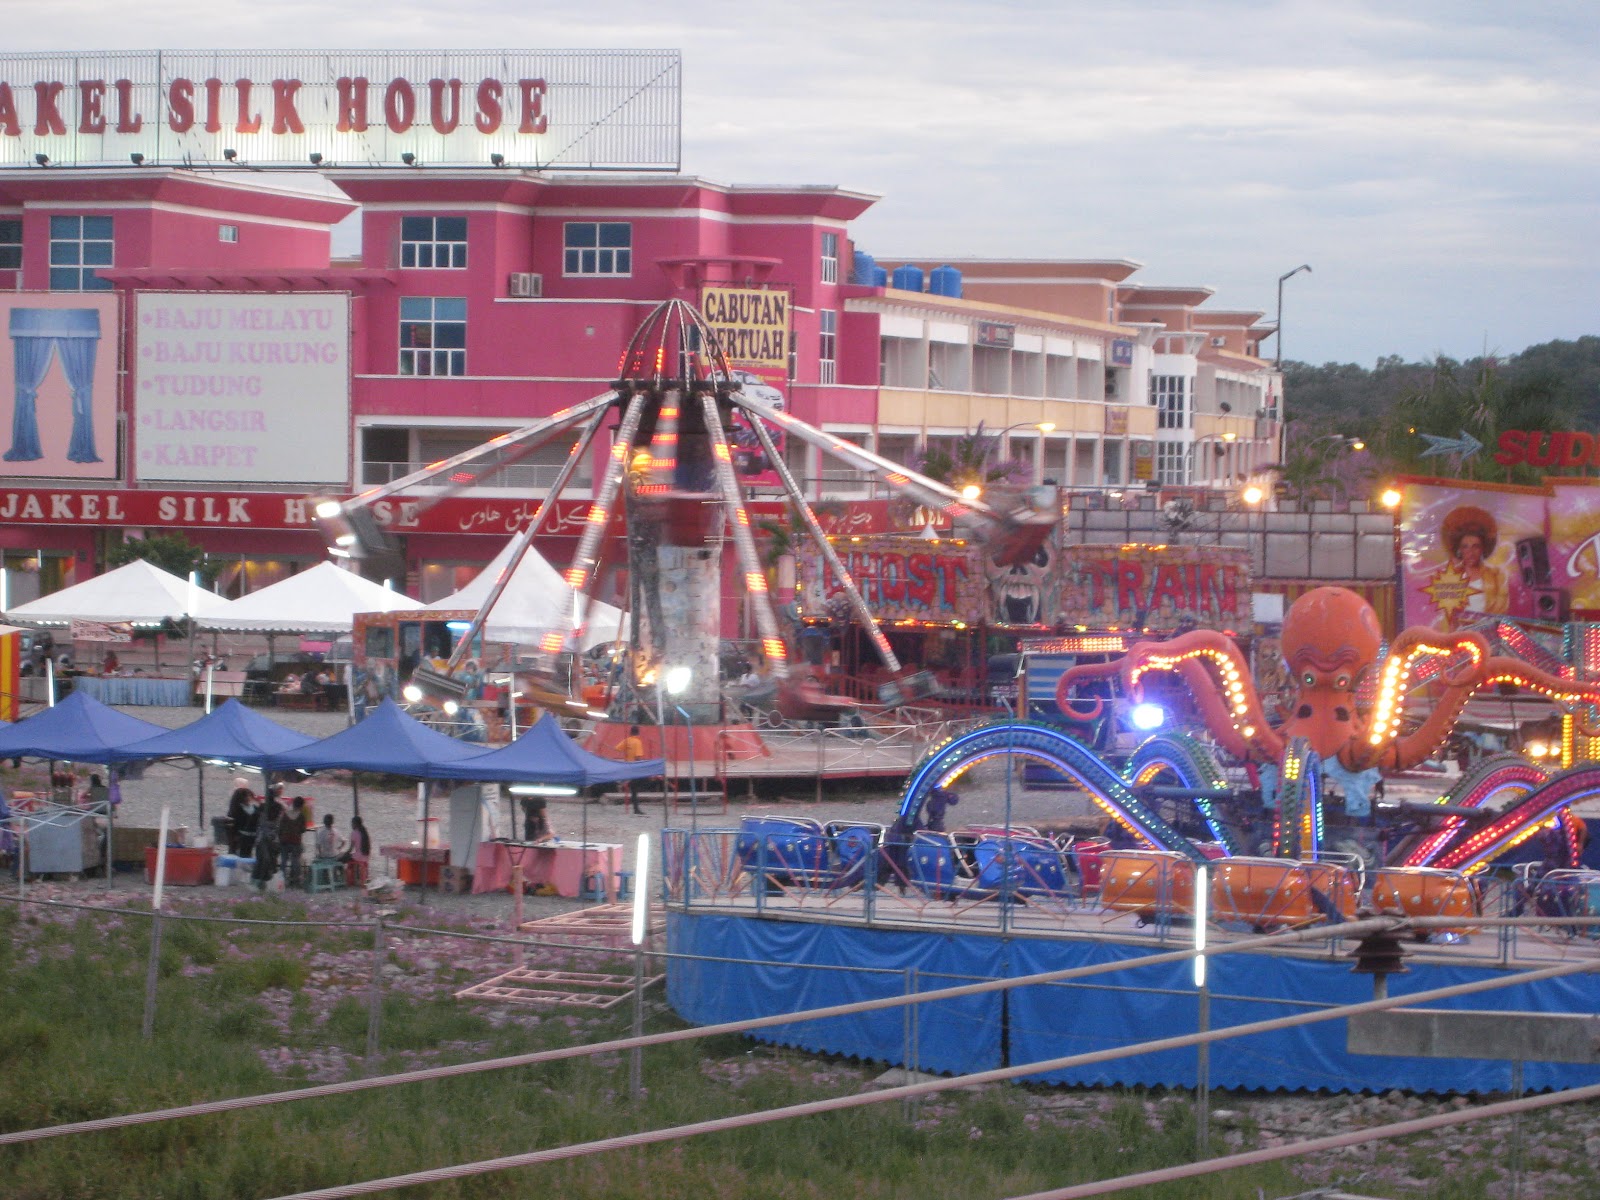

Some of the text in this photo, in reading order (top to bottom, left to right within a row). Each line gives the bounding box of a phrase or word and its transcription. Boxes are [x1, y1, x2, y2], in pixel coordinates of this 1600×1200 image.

[168, 79, 304, 134] SILK
[335, 77, 548, 134] HOUSE
[229, 308, 333, 331] MELAYU
[704, 291, 785, 324] CABUTAN
[154, 341, 339, 364] BAJU KURUNG
[154, 374, 262, 397] TUDUNG
[154, 409, 267, 432] LANGSIR
[154, 445, 258, 467] KARPET
[1496, 430, 1600, 467] SUD
[1, 493, 420, 528] JAKEL SILK HSE
[1082, 558, 1239, 615] TRAIN
